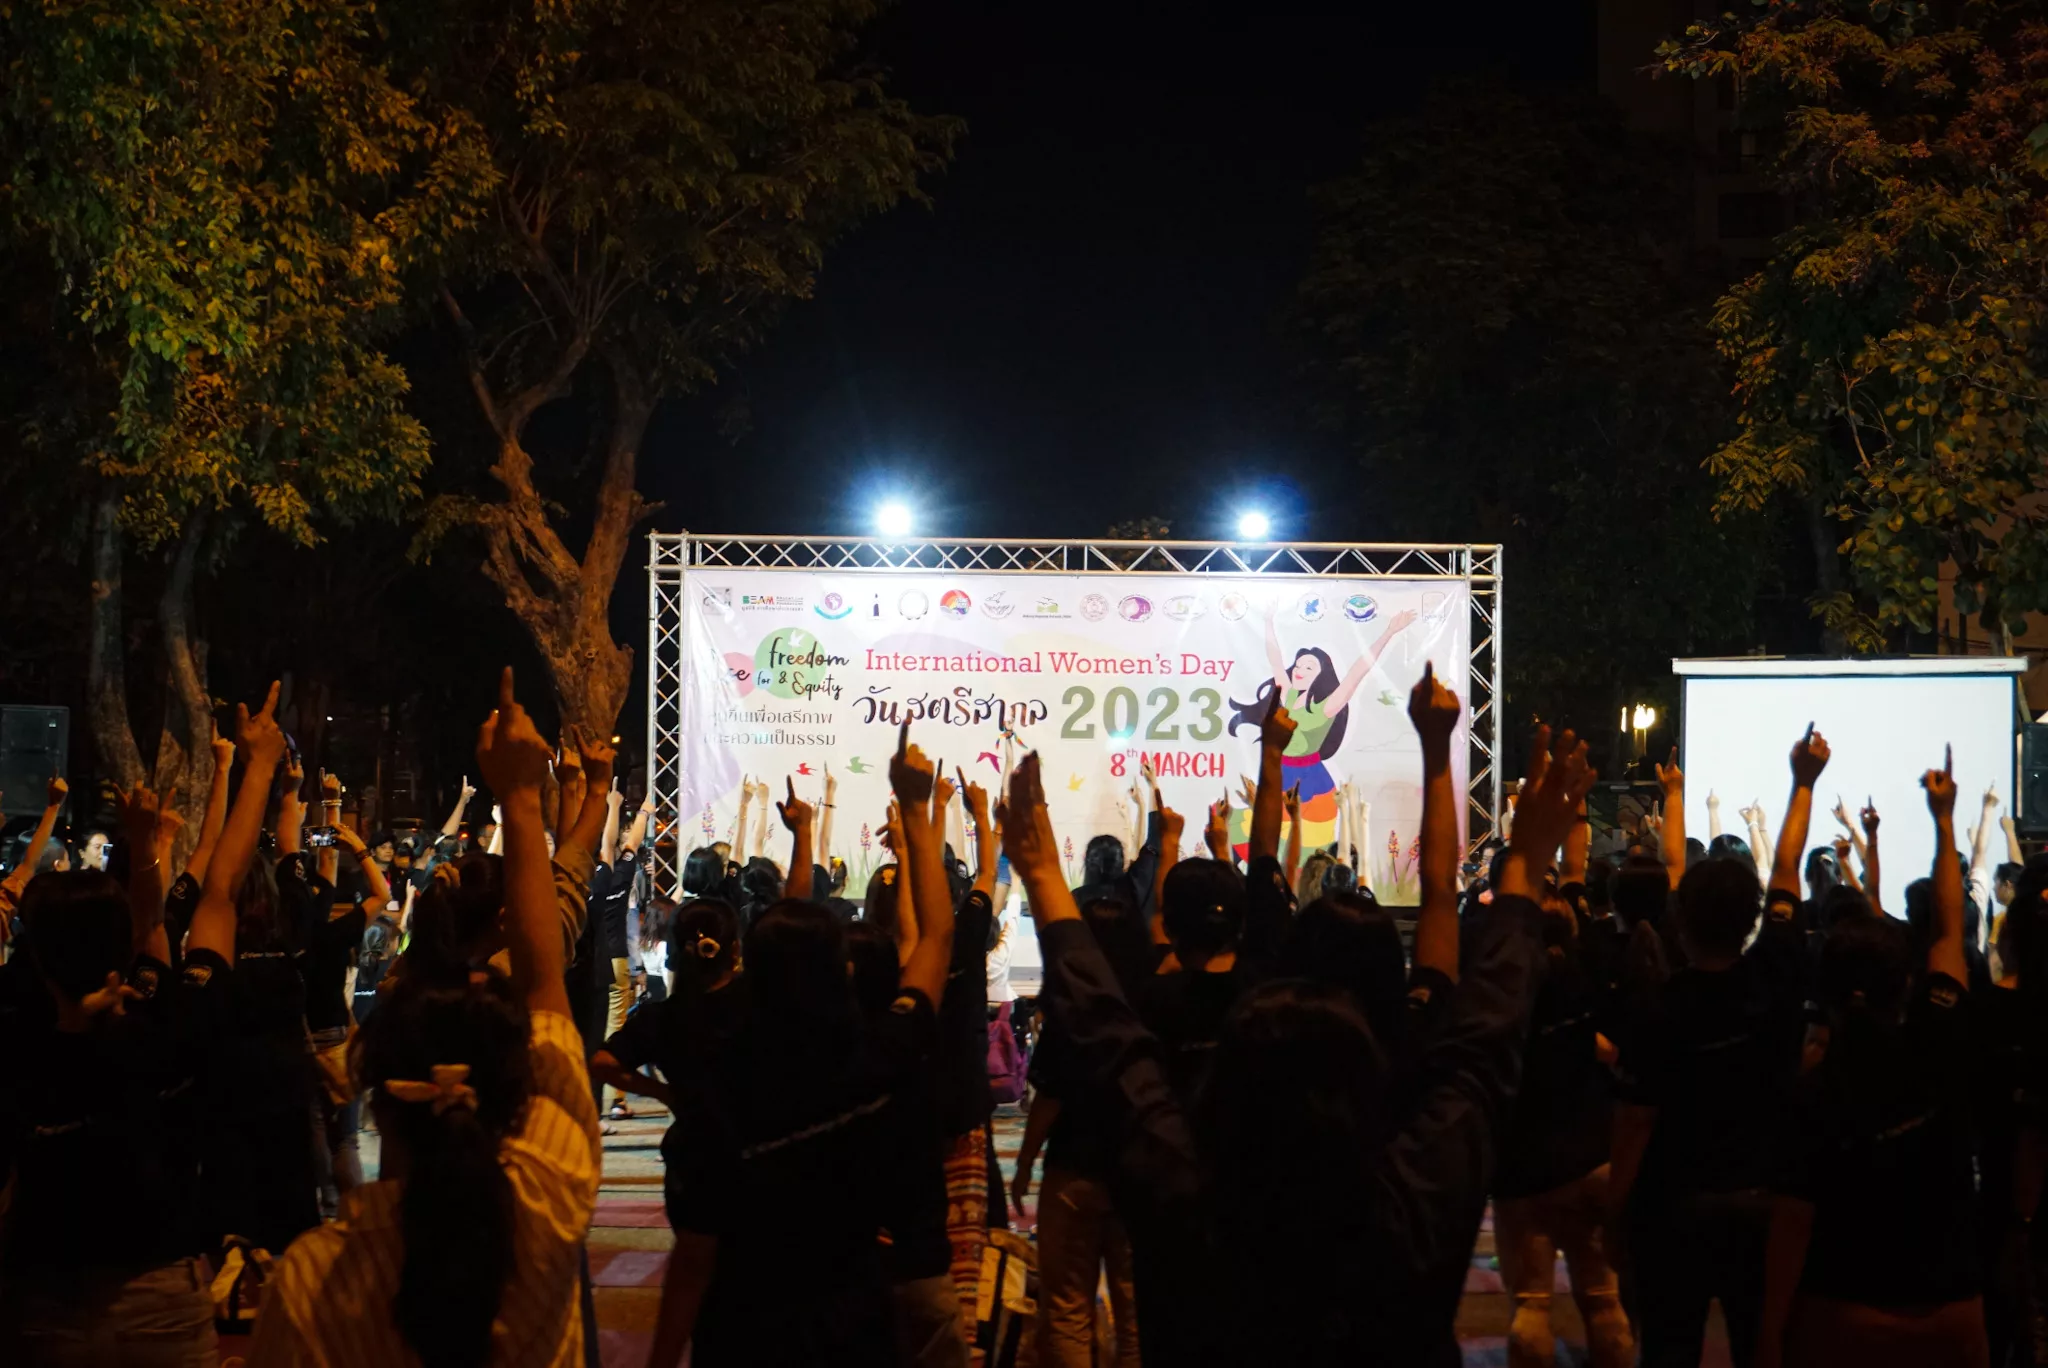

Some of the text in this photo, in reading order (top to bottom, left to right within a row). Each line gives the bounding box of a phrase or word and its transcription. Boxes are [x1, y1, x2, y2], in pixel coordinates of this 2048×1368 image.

[865, 649, 1235, 682] International Women's Day
[757, 668, 843, 701] for & Equity
[1060, 685, 1223, 741] 2023
[1140, 751, 1225, 777] MARCH
